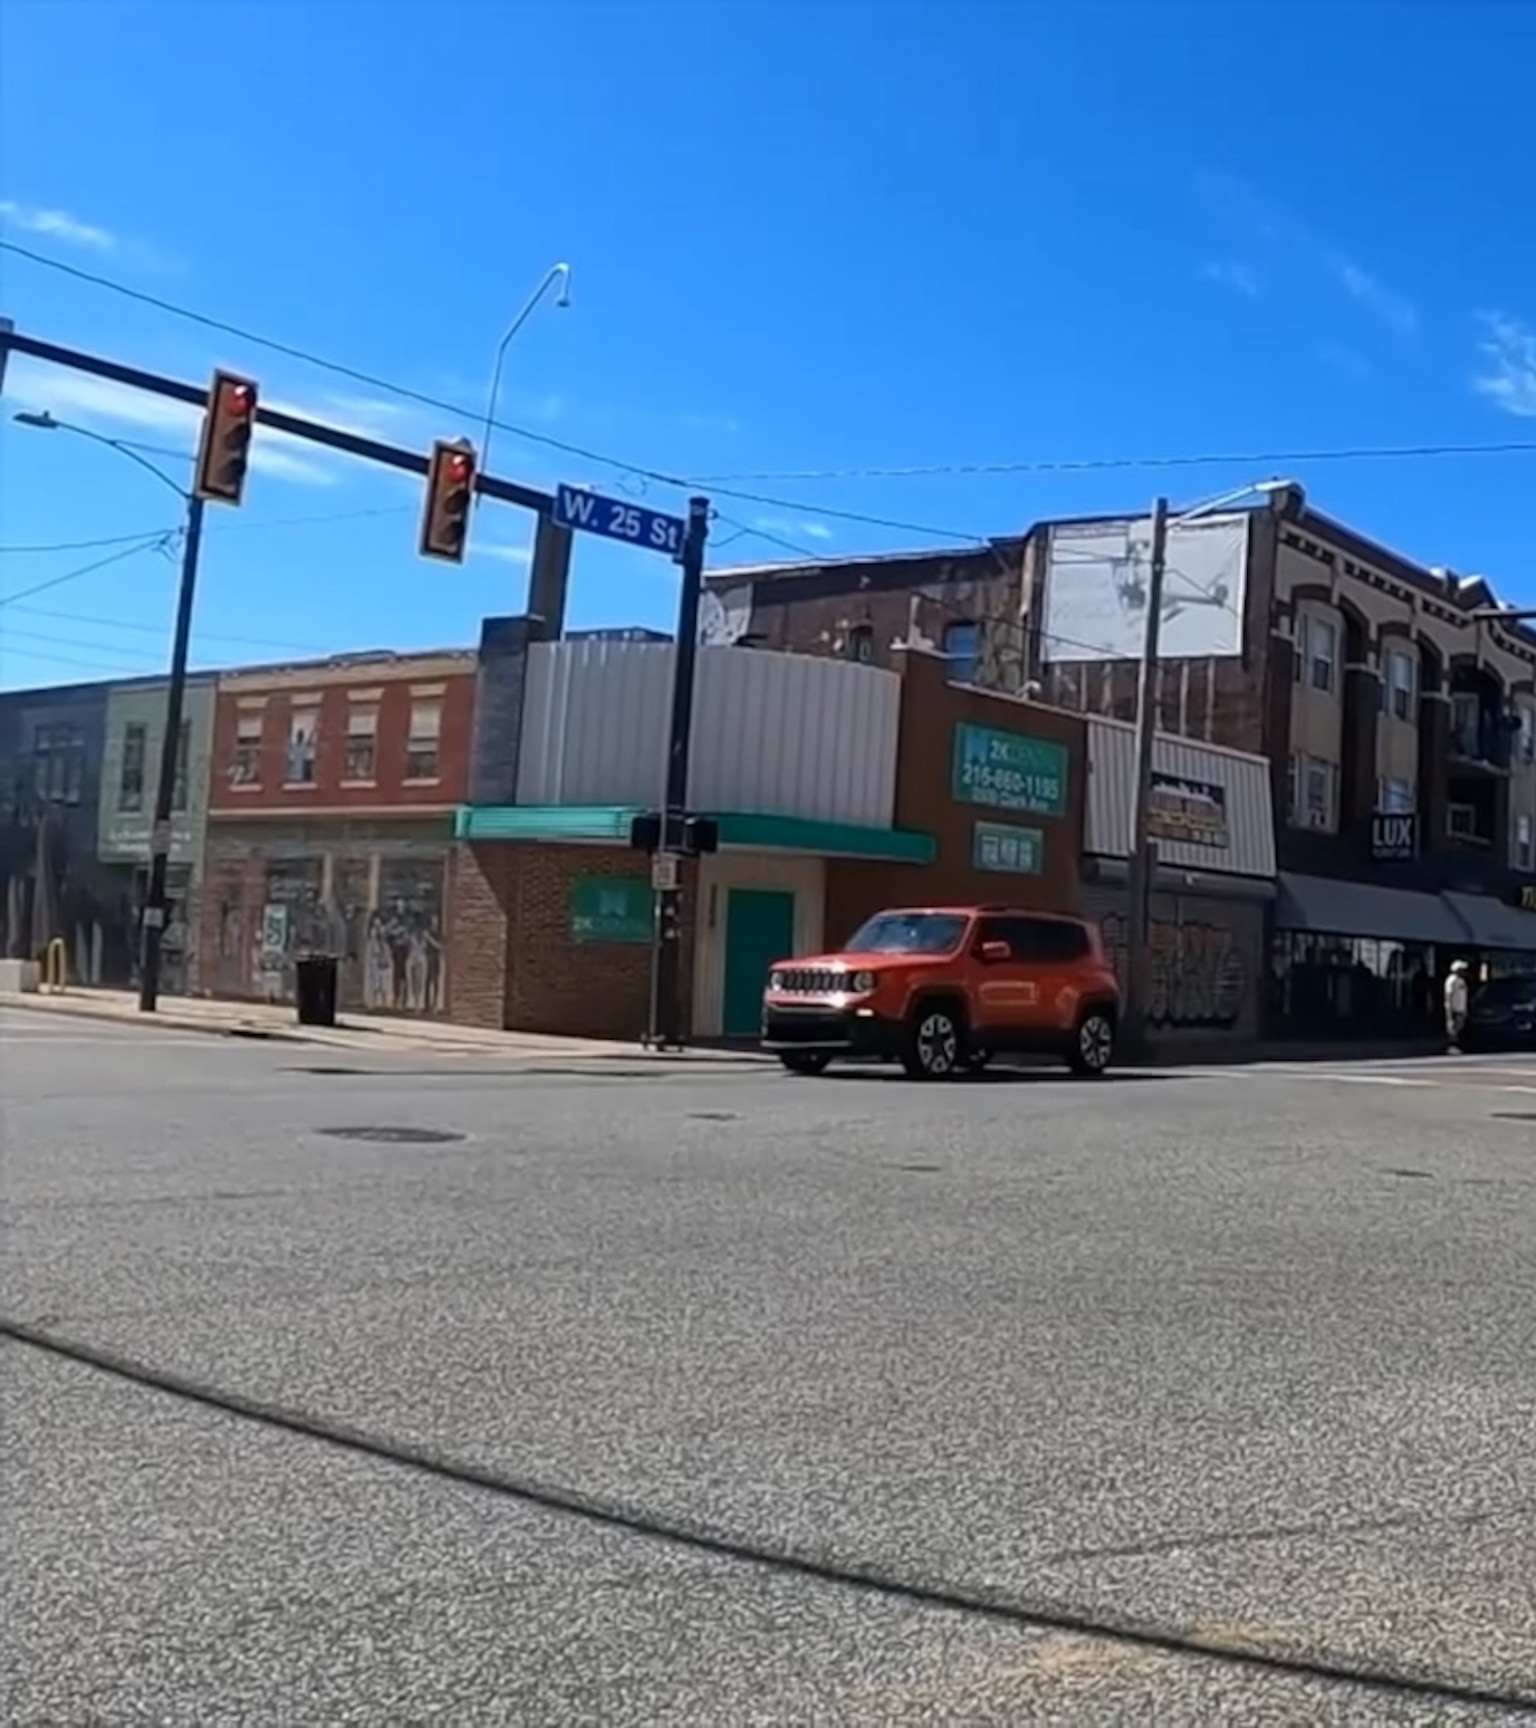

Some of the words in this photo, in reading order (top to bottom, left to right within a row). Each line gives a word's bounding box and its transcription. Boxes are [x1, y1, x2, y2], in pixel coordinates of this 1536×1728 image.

[563, 490, 598, 527] W.
[608, 506, 641, 537] 25
[649, 518, 678, 548] St
[1371, 817, 1413, 846] LUX
